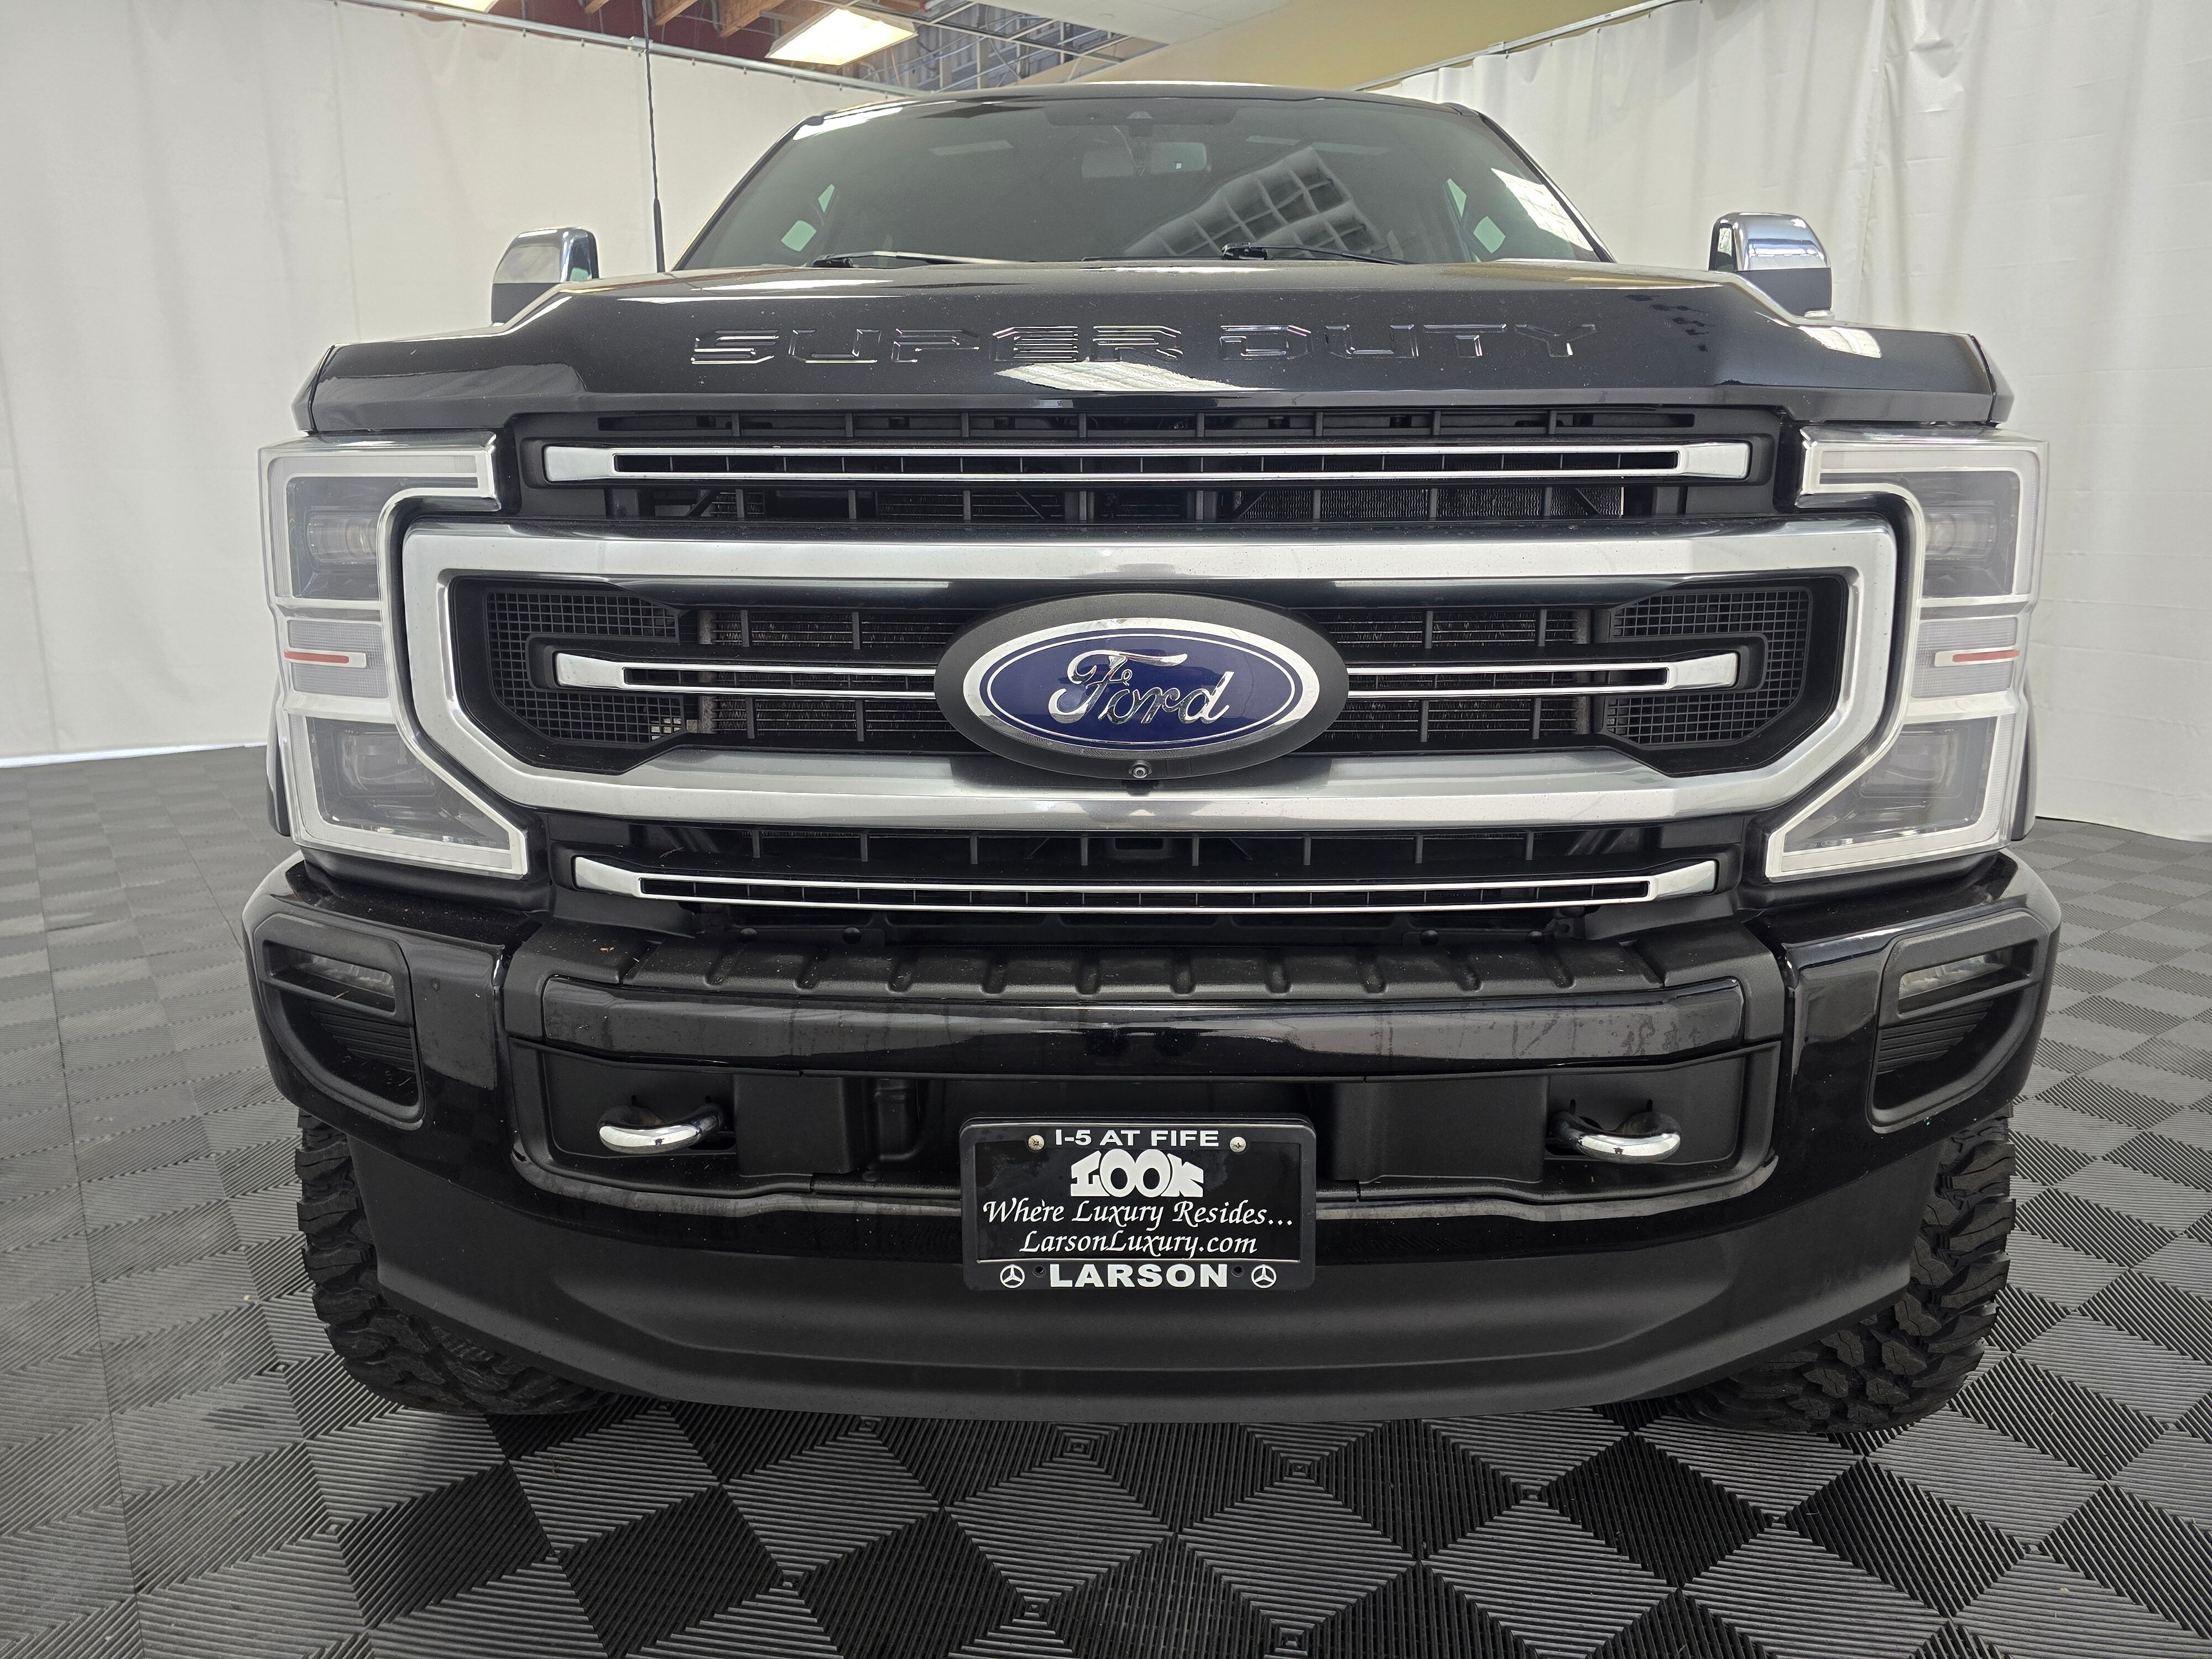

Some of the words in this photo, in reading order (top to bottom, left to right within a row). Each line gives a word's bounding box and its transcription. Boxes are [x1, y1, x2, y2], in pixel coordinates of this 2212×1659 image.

[691, 325, 1183, 364] SUPER
[1219, 325, 1596, 361] DUTY
[1048, 649, 1235, 724] Ford
[1056, 1129, 1092, 1146] I-5
[1099, 1129, 1140, 1146] AT
[1151, 1130, 1219, 1147] FIFE
[1070, 1148, 1204, 1198] LOOK
[1071, 1200, 1164, 1232] Luxury
[1172, 1199, 1292, 1228] Resides...
[1019, 1230, 1258, 1259] LarsonLuxury.com
[1050, 1264, 1228, 1287] LARSON
